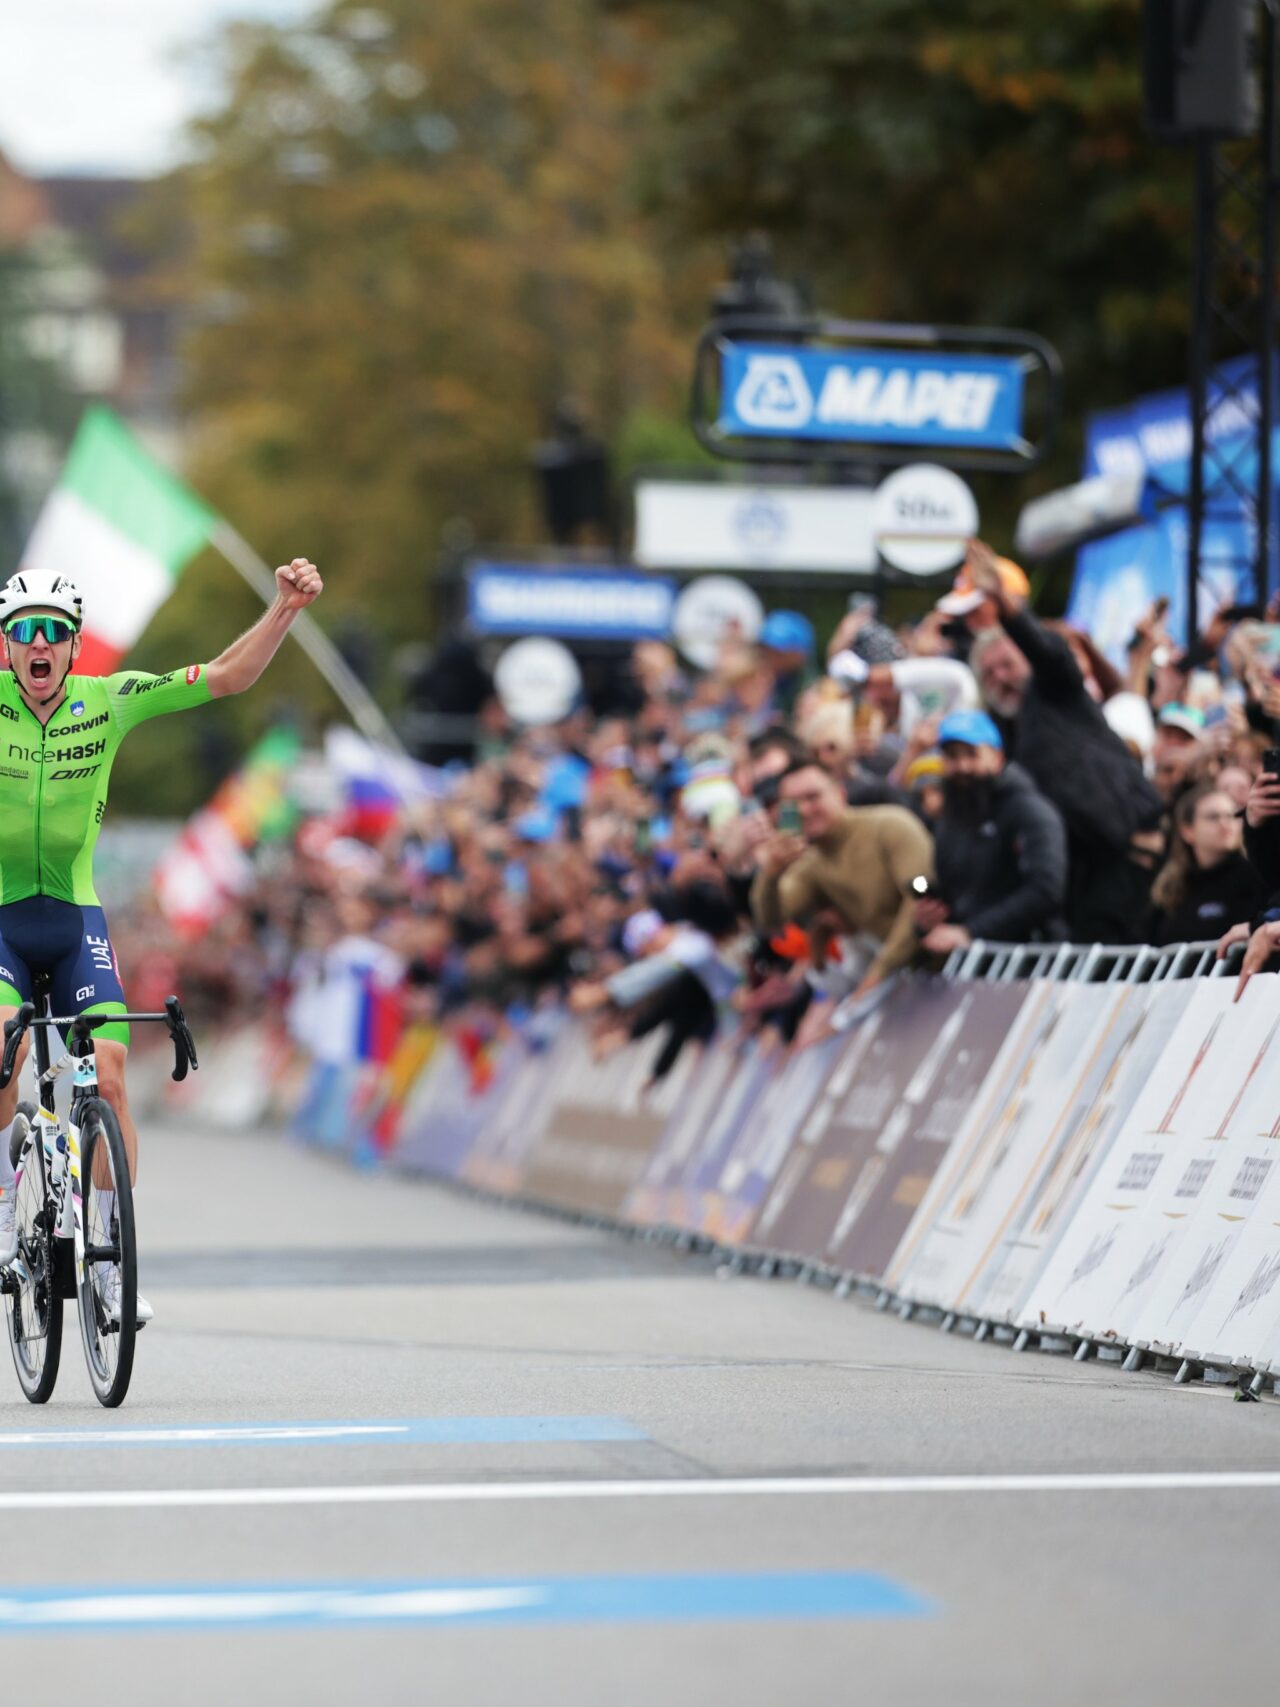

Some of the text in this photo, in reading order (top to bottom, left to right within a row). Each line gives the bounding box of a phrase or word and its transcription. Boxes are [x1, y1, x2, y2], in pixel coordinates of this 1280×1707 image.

[815, 365, 1000, 431] MAPEI
[48, 711, 109, 738] CORWIN
[48, 763, 101, 780] DMT
[86, 935, 112, 970] UAE
